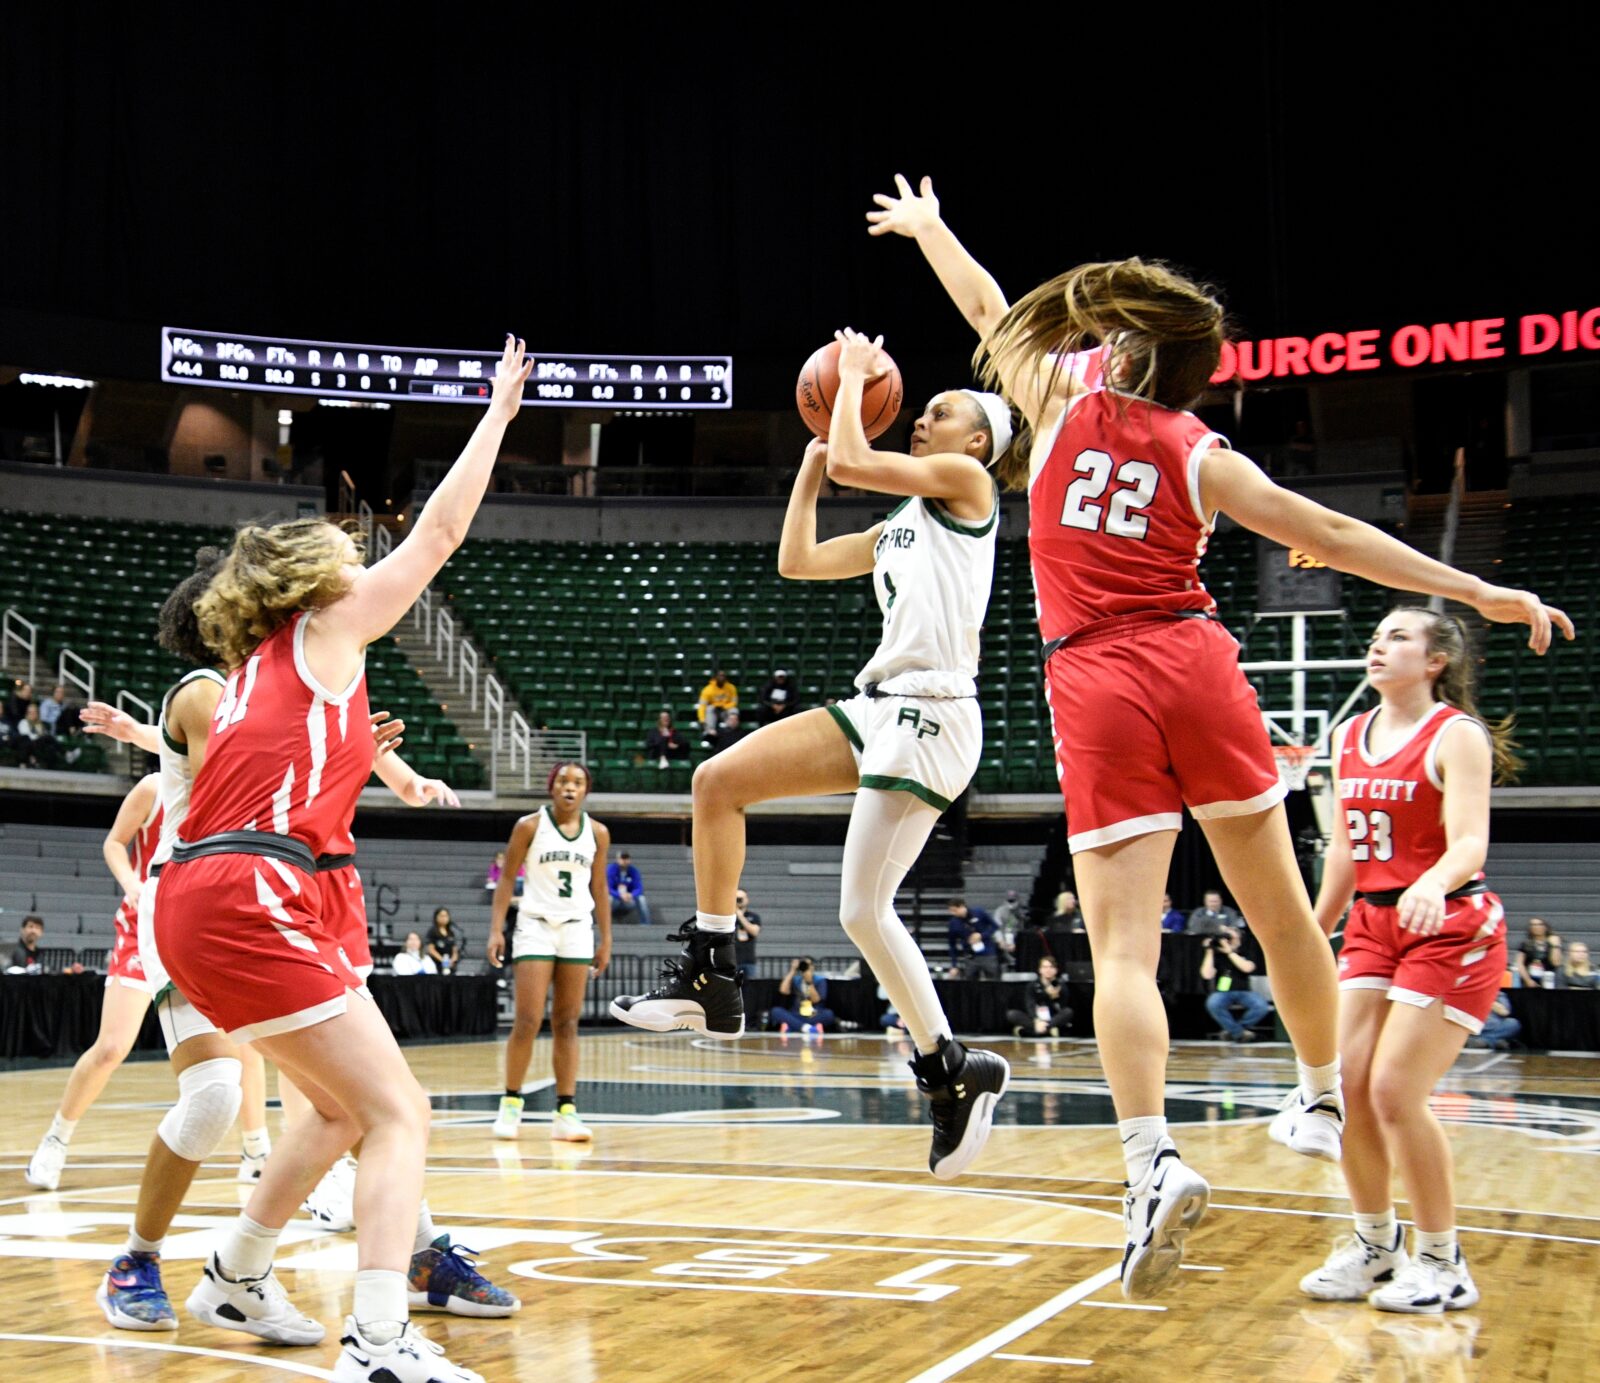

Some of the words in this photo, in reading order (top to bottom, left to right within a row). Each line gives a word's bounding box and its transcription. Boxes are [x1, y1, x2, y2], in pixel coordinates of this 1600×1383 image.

[173, 337, 203, 357] FG%
[216, 342, 255, 361] 3FG%
[266, 346, 296, 365] FT%
[308, 350, 321, 366] R
[333, 352, 346, 368] A
[381, 355, 402, 372] TO
[414, 358, 438, 376] AP
[537, 362, 577, 379] 3FG%
[589, 364, 618, 380] FT%
[630, 364, 643, 380] R
[654, 365, 668, 381] A
[703, 365, 724, 381] TO
[1209, 329, 1380, 384] OURCE
[1390, 317, 1505, 368] ONE
[388, 377, 397, 391] 1
[432, 384, 464, 396] FIRST
[658, 386, 667, 400] 1
[711, 386, 721, 400] 2
[1060, 448, 1161, 542] 22
[888, 528, 915, 549] PREP
[214, 655, 262, 735] 41
[897, 707, 940, 738] AP
[1370, 779, 1418, 802] CITY
[1346, 808, 1393, 862] 23
[539, 851, 570, 864] ARBOR
[558, 871, 573, 898] 3
